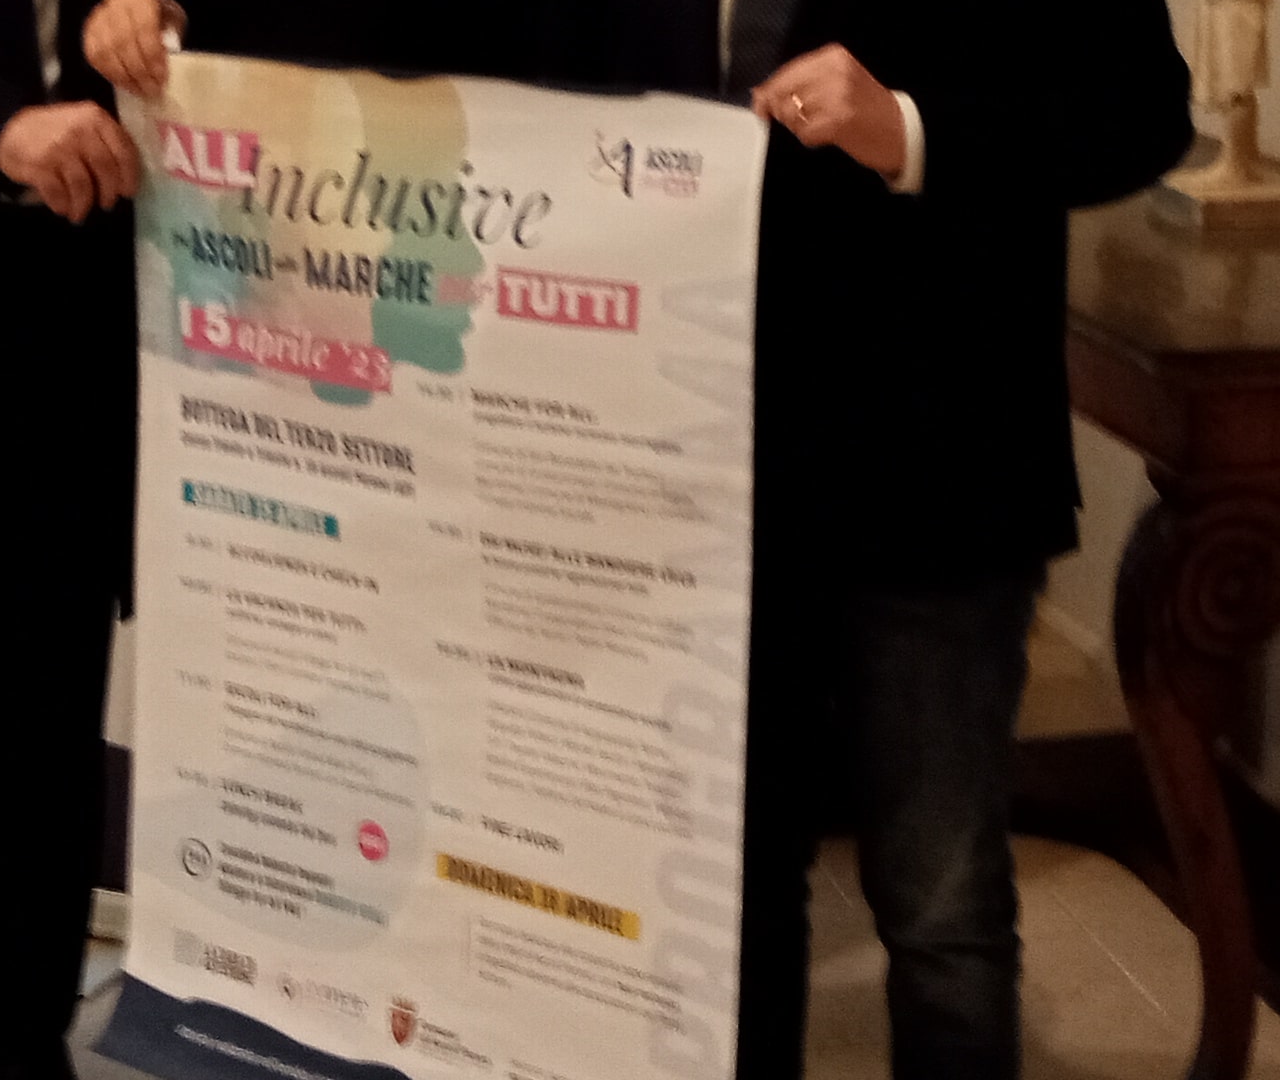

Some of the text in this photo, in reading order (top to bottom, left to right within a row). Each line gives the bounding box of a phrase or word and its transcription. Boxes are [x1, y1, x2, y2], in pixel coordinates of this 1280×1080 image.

[161, 126, 255, 188] ALL
[191, 224, 273, 281] ASCOLI
[303, 249, 433, 307] MARCHE
[502, 275, 630, 328] TUTTI
[236, 322, 332, 370] aprile
[180, 394, 251, 435] BOTTEGA
[253, 410, 285, 445] DEL
[283, 417, 339, 457] TERZO
[340, 432, 417, 476] SETTORE
[448, 853, 534, 906] DOMENICA
[566, 892, 624, 938] APRILE
